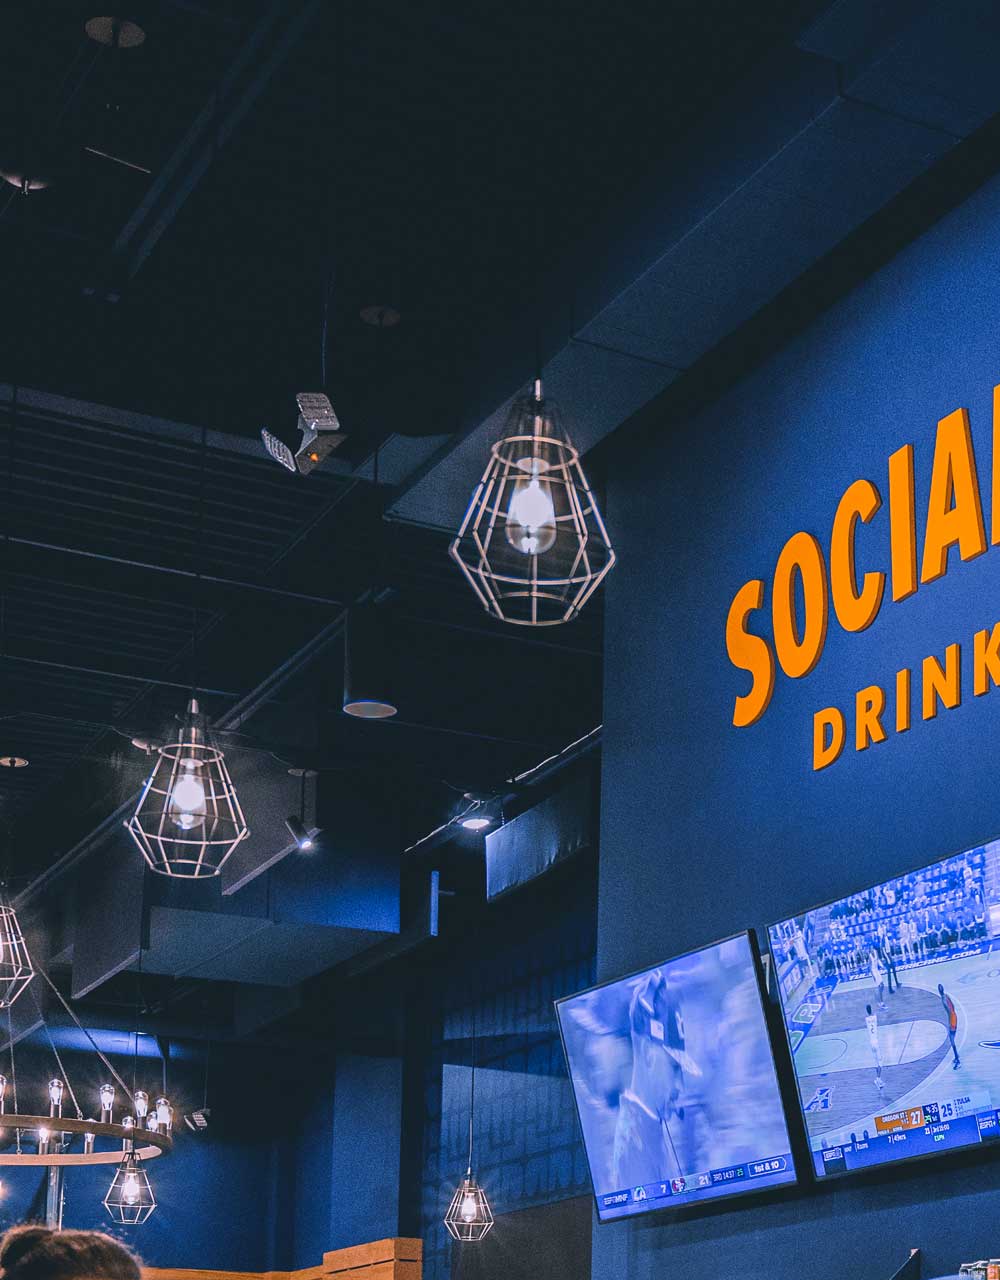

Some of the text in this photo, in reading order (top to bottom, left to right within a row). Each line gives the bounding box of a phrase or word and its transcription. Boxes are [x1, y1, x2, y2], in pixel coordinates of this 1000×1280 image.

[941, 1104, 953, 1118] 25
[910, 1111, 922, 1125] 27
[754, 1162, 780, 1174] 1st & 10
[699, 1176, 709, 1185] 21
[661, 1185, 667, 1193] 7
